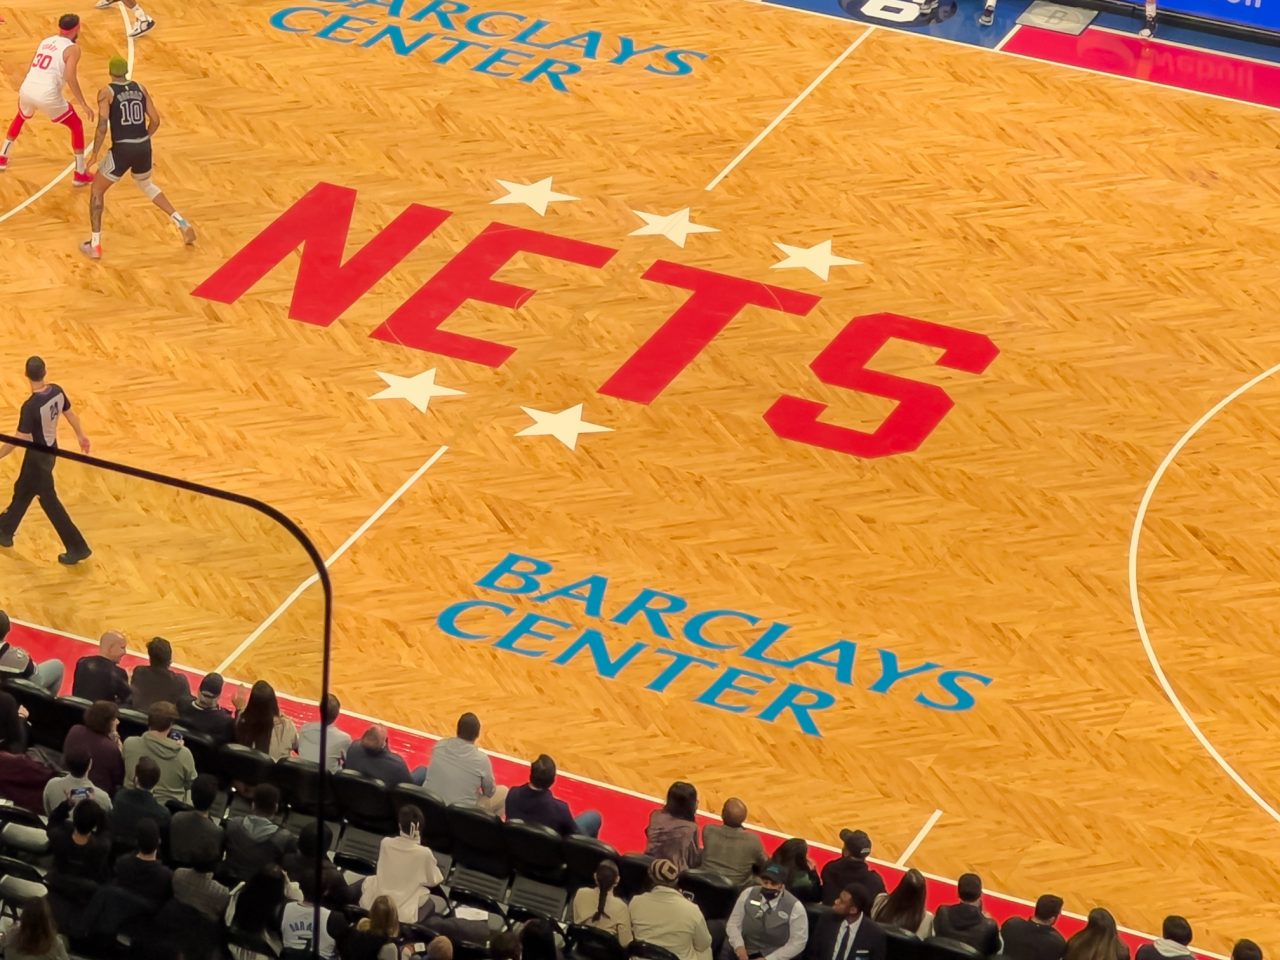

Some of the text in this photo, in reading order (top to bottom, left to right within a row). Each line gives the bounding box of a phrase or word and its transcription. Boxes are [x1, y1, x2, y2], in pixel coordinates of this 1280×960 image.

[32, 53, 53, 70] 30
[269, 5, 582, 92] CENTER
[120, 100, 144, 126] 10
[190, 181, 1000, 459] NETS
[436, 599, 838, 737] CENTER
[475, 552, 994, 713] BARCLAYS
